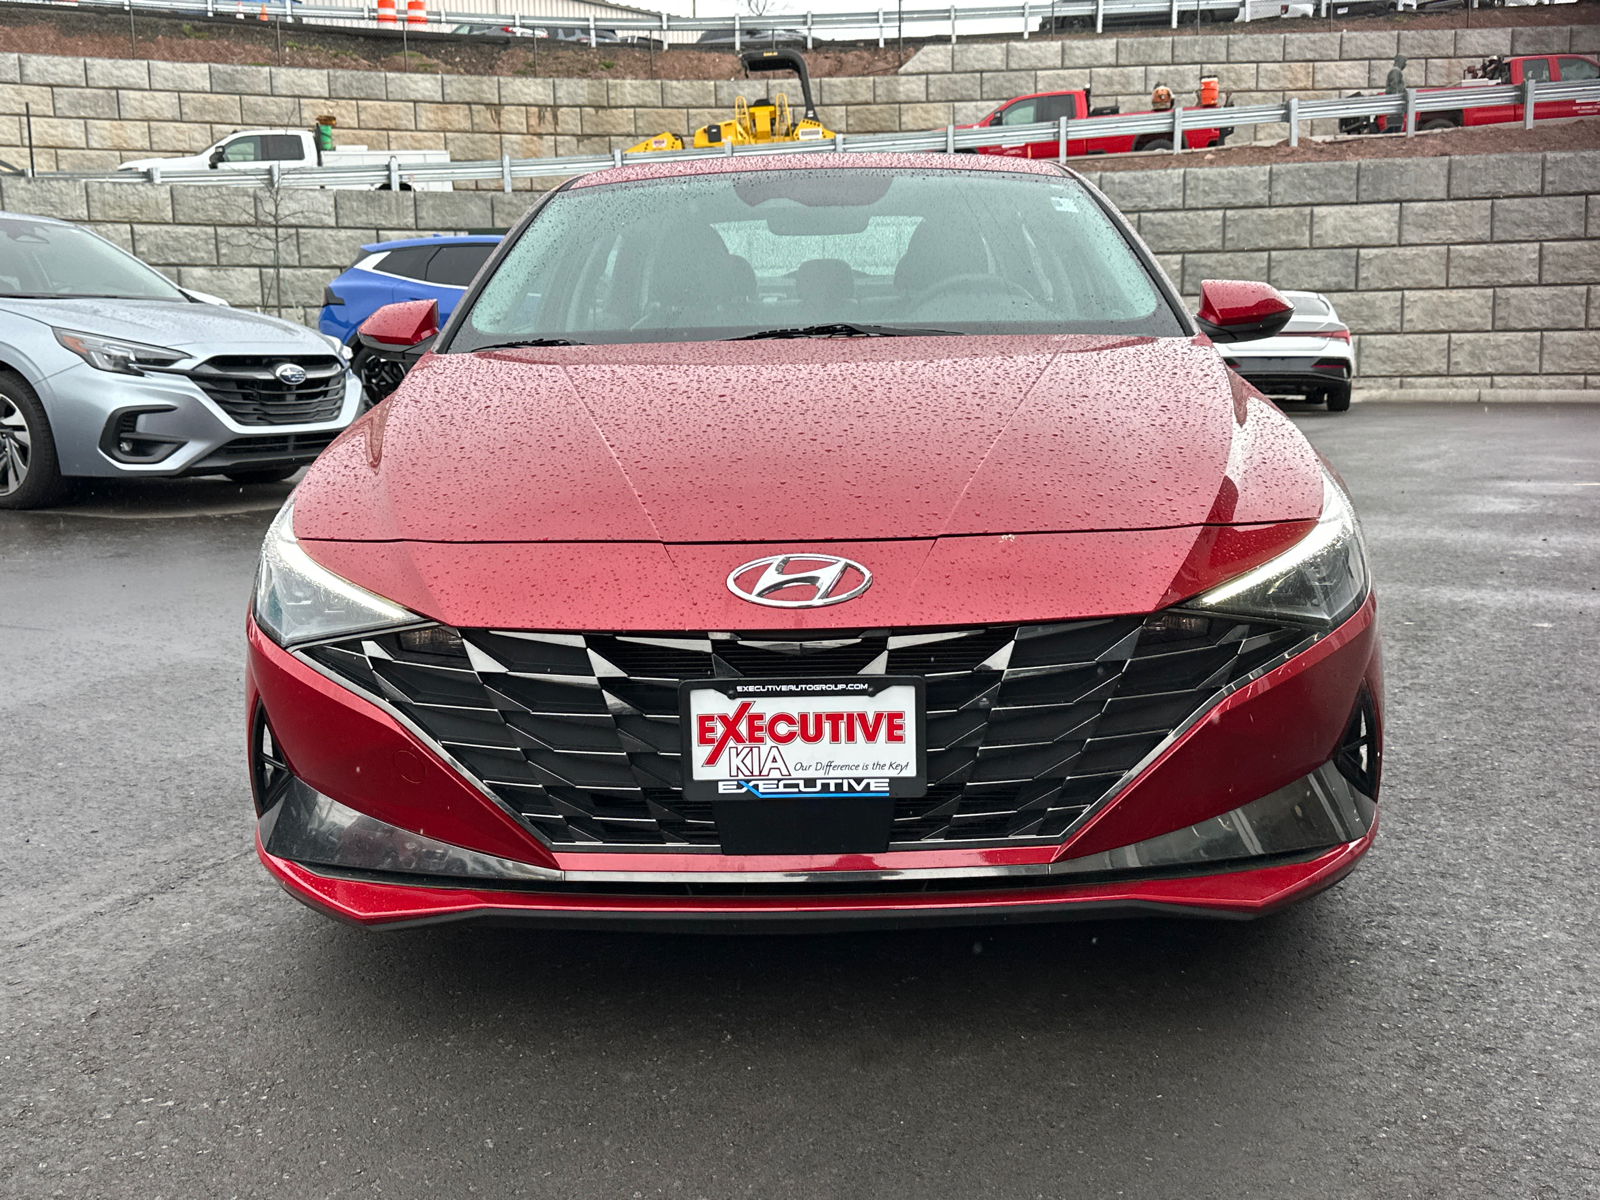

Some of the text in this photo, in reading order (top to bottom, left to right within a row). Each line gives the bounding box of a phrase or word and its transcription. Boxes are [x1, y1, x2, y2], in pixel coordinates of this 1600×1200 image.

[736, 683, 868, 692] EXECUTIVEAUTOGROUP.COM
[697, 701, 906, 767] EXECUTIVE
[729, 746, 909, 777] KIA Our Difference is the Key!
[718, 778, 890, 794] EXECUTIVE
